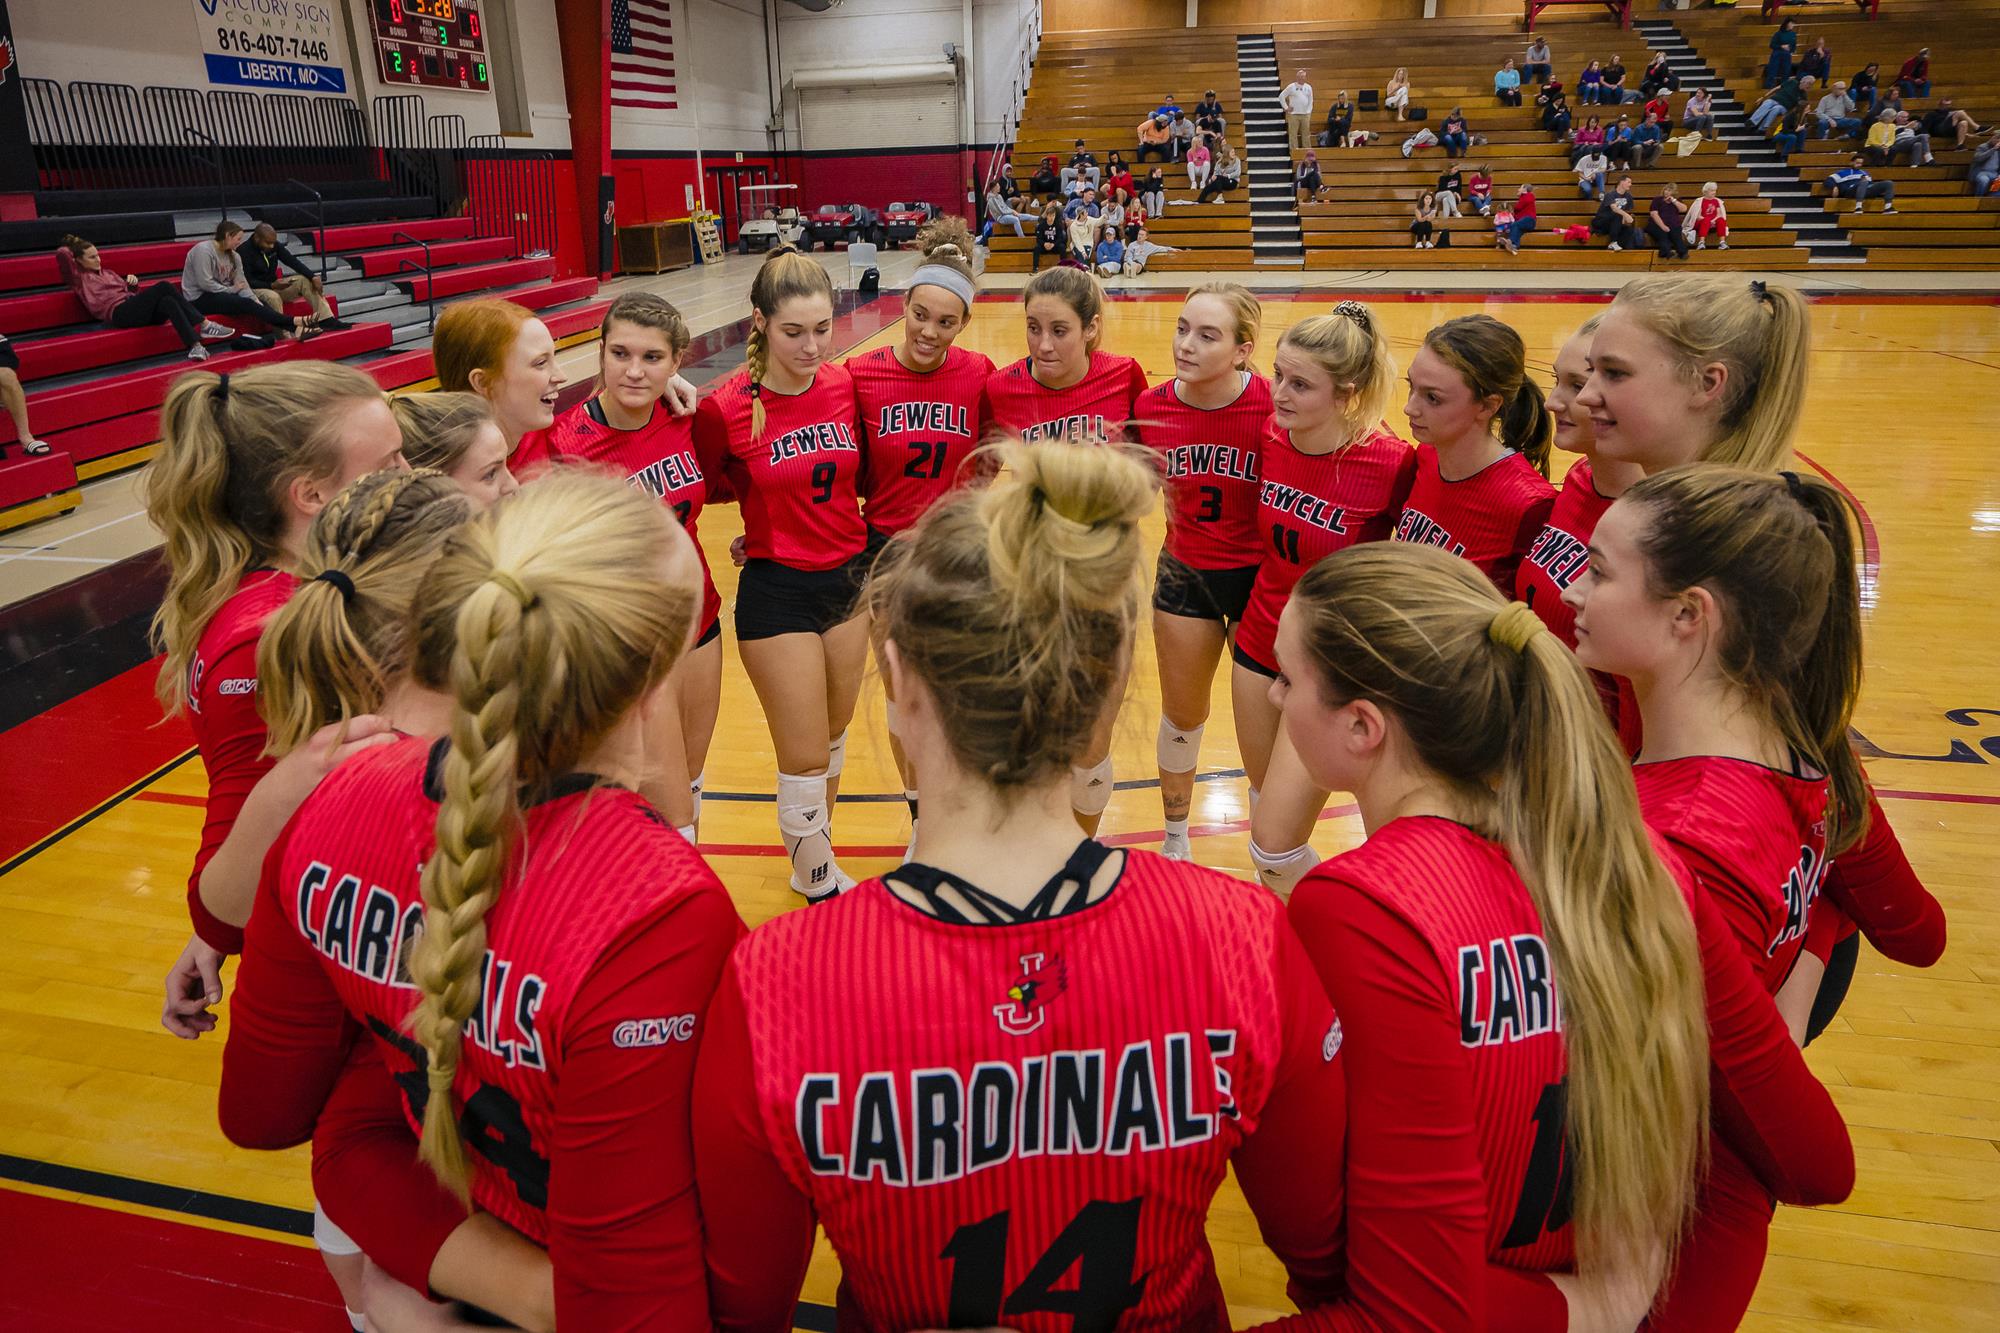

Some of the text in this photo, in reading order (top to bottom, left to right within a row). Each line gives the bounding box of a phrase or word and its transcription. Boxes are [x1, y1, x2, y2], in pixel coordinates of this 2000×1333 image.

[225, 11, 332, 36] COMPANY
[294, 2, 331, 24] SIGN
[469, 13, 480, 37] 0
[217, 28, 328, 61] 816-407-7446
[383, 41, 400, 52] FOULS
[418, 46, 437, 57] PLAYER
[439, 25, 448, 45] 3
[238, 61, 319, 86] LIBERTY, MO
[393, 51, 402, 73] 2
[478, 63, 487, 82] 0
[877, 401, 971, 438] JEWELL
[770, 421, 858, 466] JEWELL
[904, 441, 948, 479] 21
[625, 451, 704, 498] WELL
[811, 461, 837, 505] 9
[1195, 486, 1222, 522] 3
[1260, 480, 1347, 536] EWELL
[1272, 523, 1299, 565] 11
[1396, 507, 1466, 559] EWEL
[219, 679, 257, 695] GLV
[613, 1014, 696, 1048] GLVC
[796, 1028, 1242, 1188] CARDINALS
[939, 1196, 1149, 1333] 14
